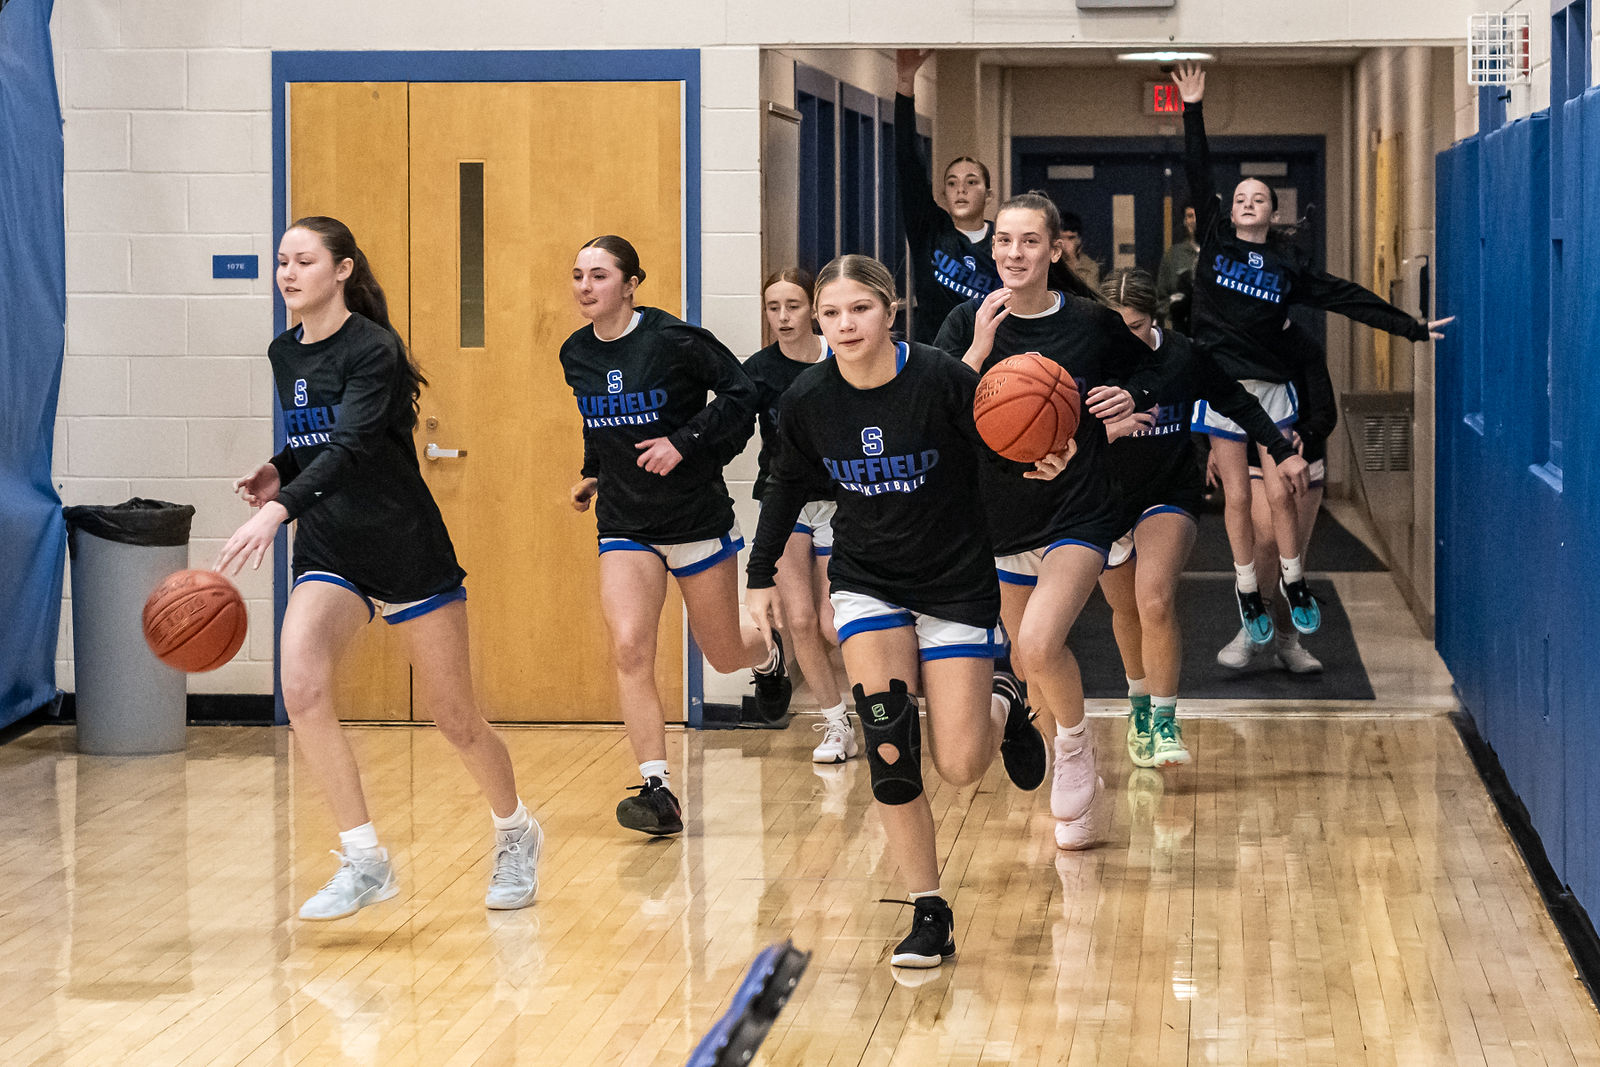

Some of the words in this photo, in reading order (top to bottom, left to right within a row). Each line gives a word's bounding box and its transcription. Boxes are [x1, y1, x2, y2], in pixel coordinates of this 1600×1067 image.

[1154, 85, 1185, 112] EXI
[1248, 251, 1264, 269] S
[1216, 274, 1281, 303] BASKETBALL
[294, 378, 308, 407] S
[606, 369, 623, 394] S
[586, 412, 659, 428] BASKETBALL
[861, 426, 884, 456] S
